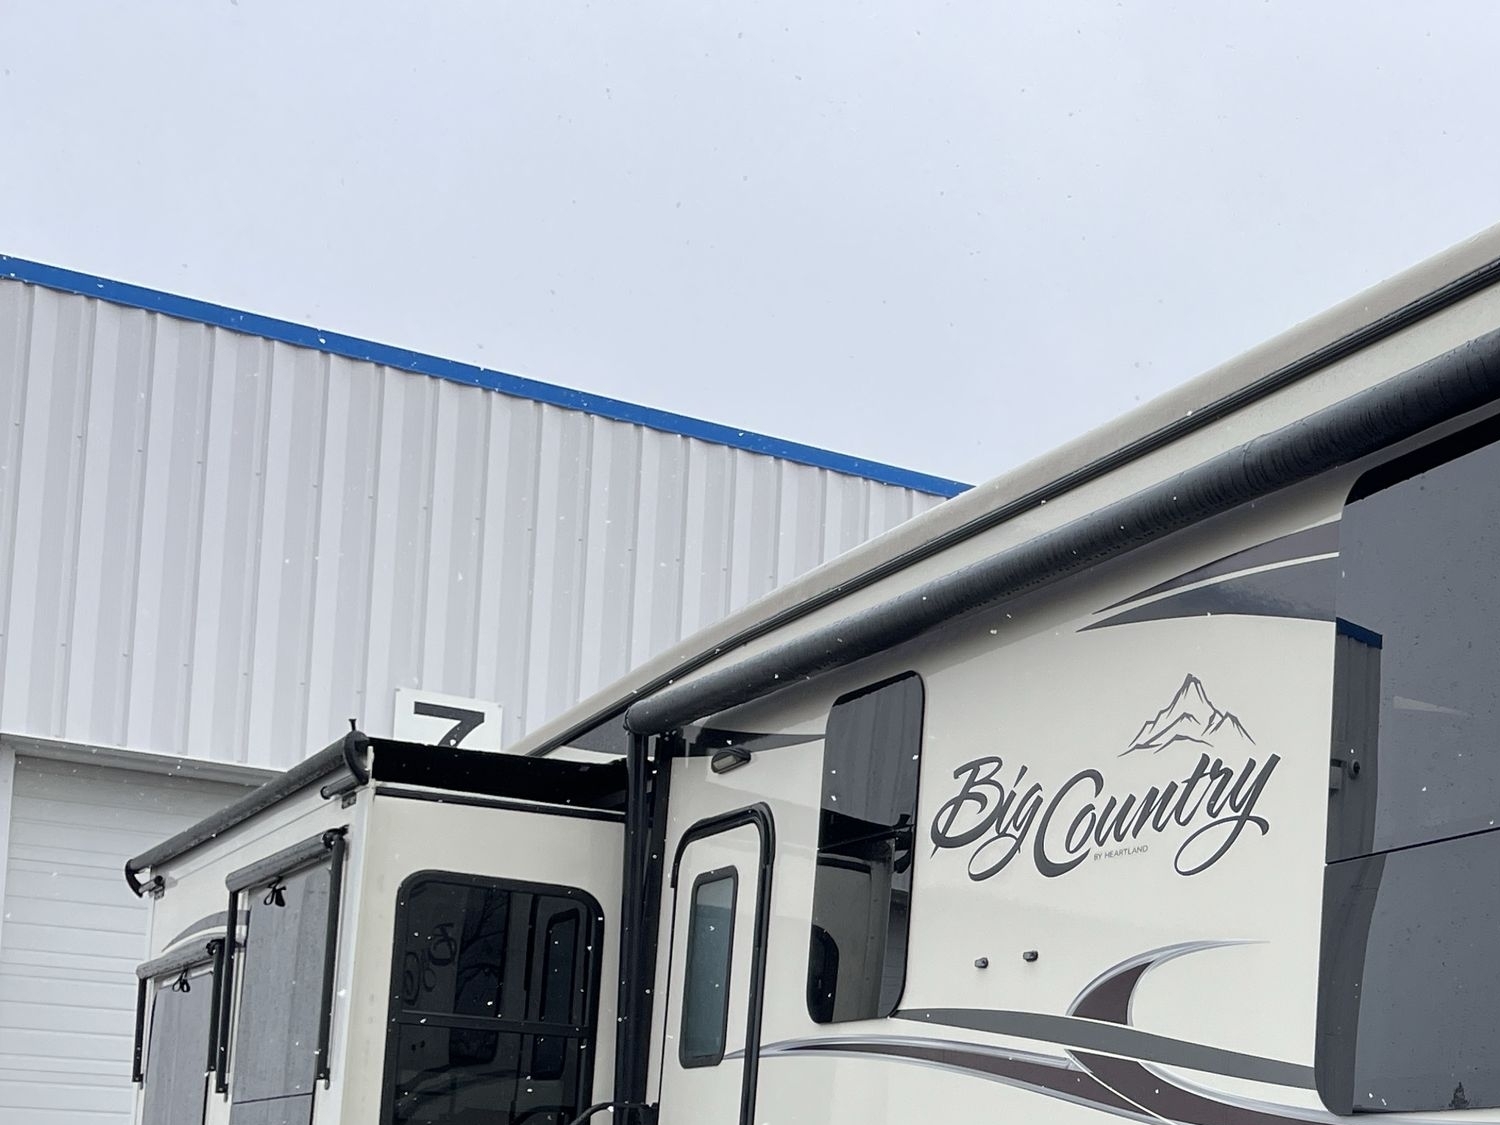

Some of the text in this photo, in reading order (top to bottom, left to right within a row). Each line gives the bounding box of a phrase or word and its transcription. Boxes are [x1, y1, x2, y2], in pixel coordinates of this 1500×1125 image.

[413, 700, 485, 748] 7
[930, 752, 1281, 881] Big Country
[1093, 844, 1149, 861] BY HEARTLAND
